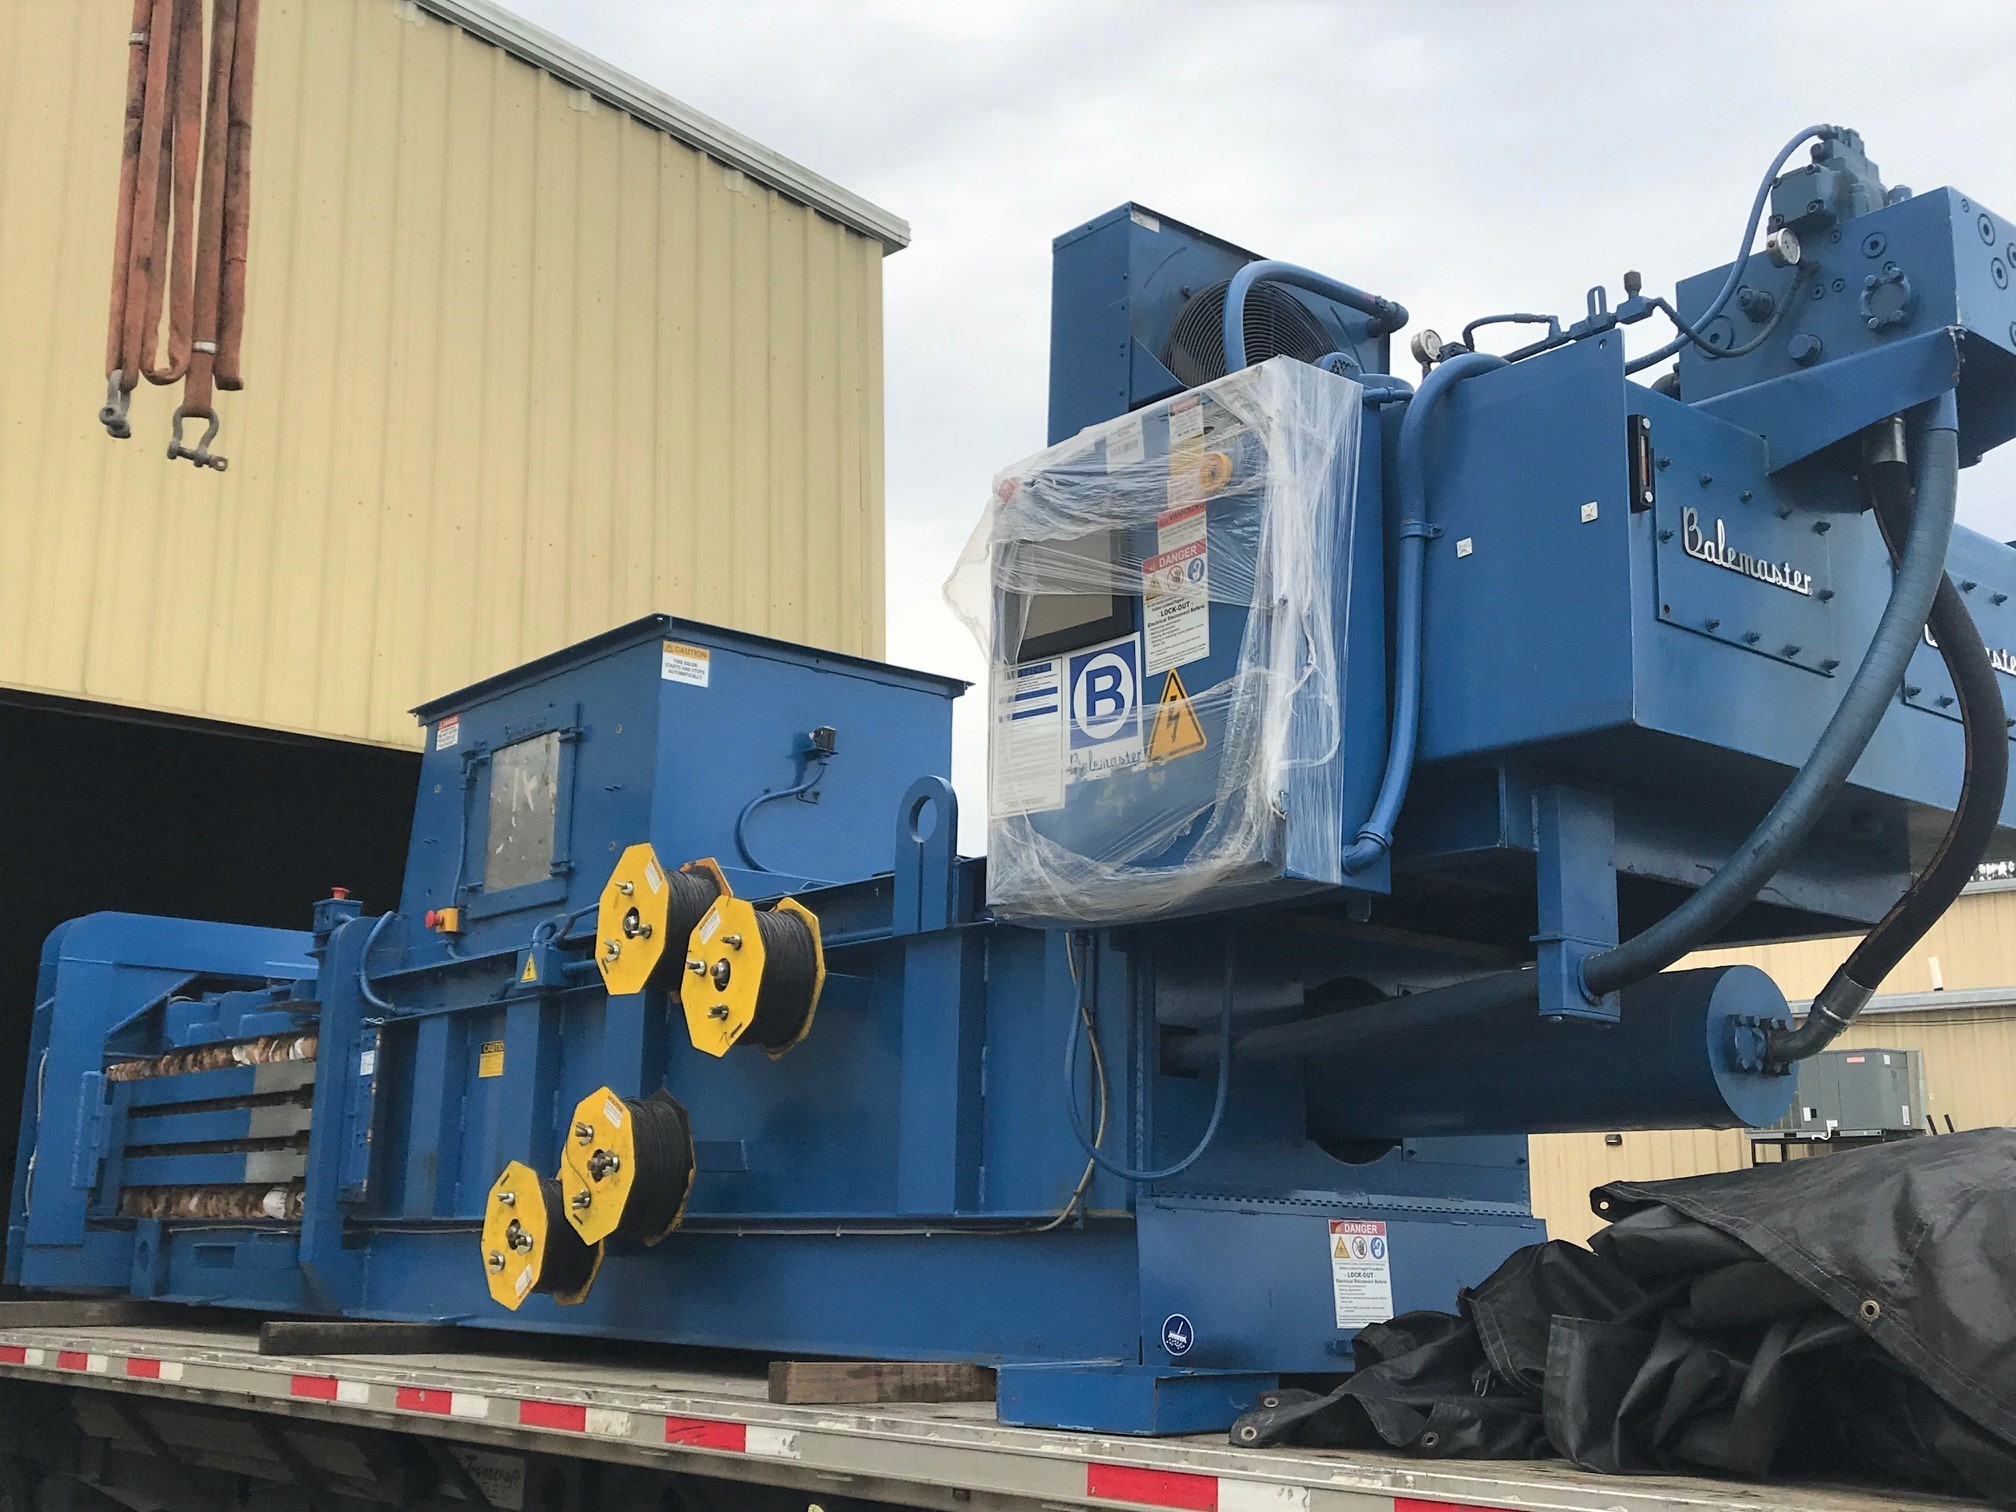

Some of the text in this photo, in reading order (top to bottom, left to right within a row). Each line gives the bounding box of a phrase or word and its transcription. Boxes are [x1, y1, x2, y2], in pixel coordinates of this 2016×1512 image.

[1159, 545, 1198, 568] DANGER
[1682, 506, 1812, 594] Balemaster
[674, 646, 707, 658] CAUTION
[1085, 664, 1125, 728] B
[483, 1042, 504, 1053] CAUTIO
[1344, 1223, 1378, 1234] DANGER
